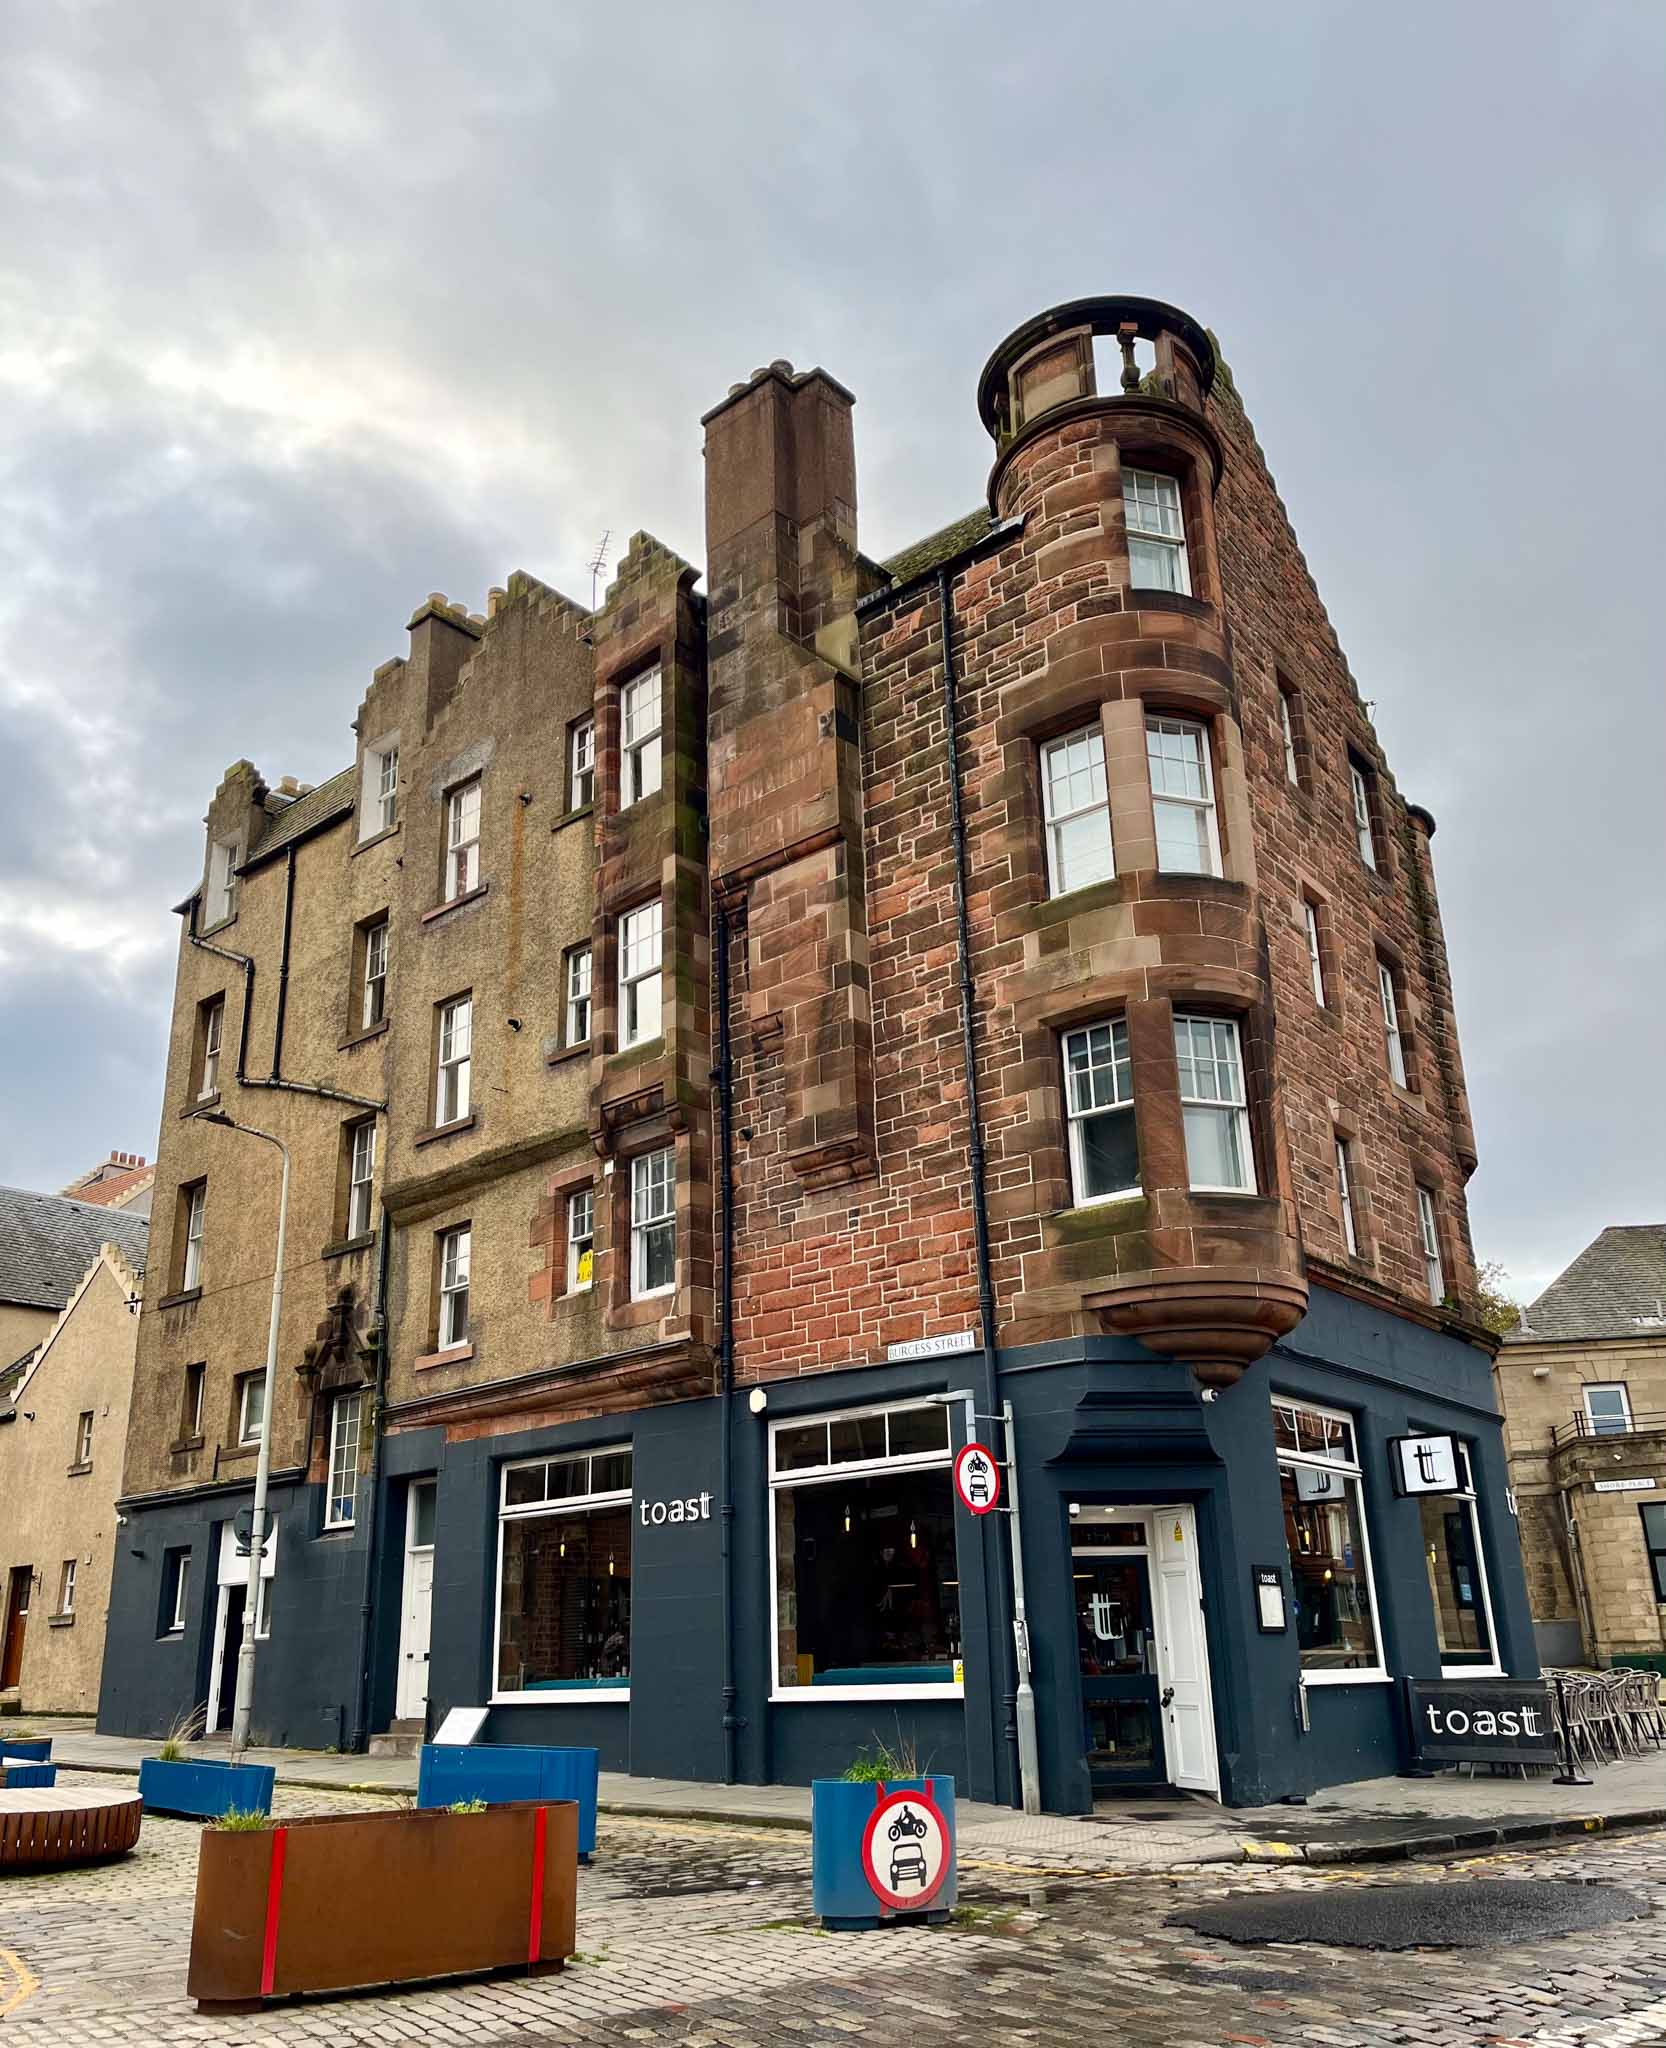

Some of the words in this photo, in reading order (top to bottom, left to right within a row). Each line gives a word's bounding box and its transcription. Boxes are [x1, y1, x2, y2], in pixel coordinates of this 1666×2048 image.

[889, 1342, 932, 1359] BURGESS
[935, 1334, 972, 1351] STREET
[640, 1491, 714, 1525] toast
[1261, 1573, 1277, 1584] toast
[1426, 1703, 1545, 1737] toast
